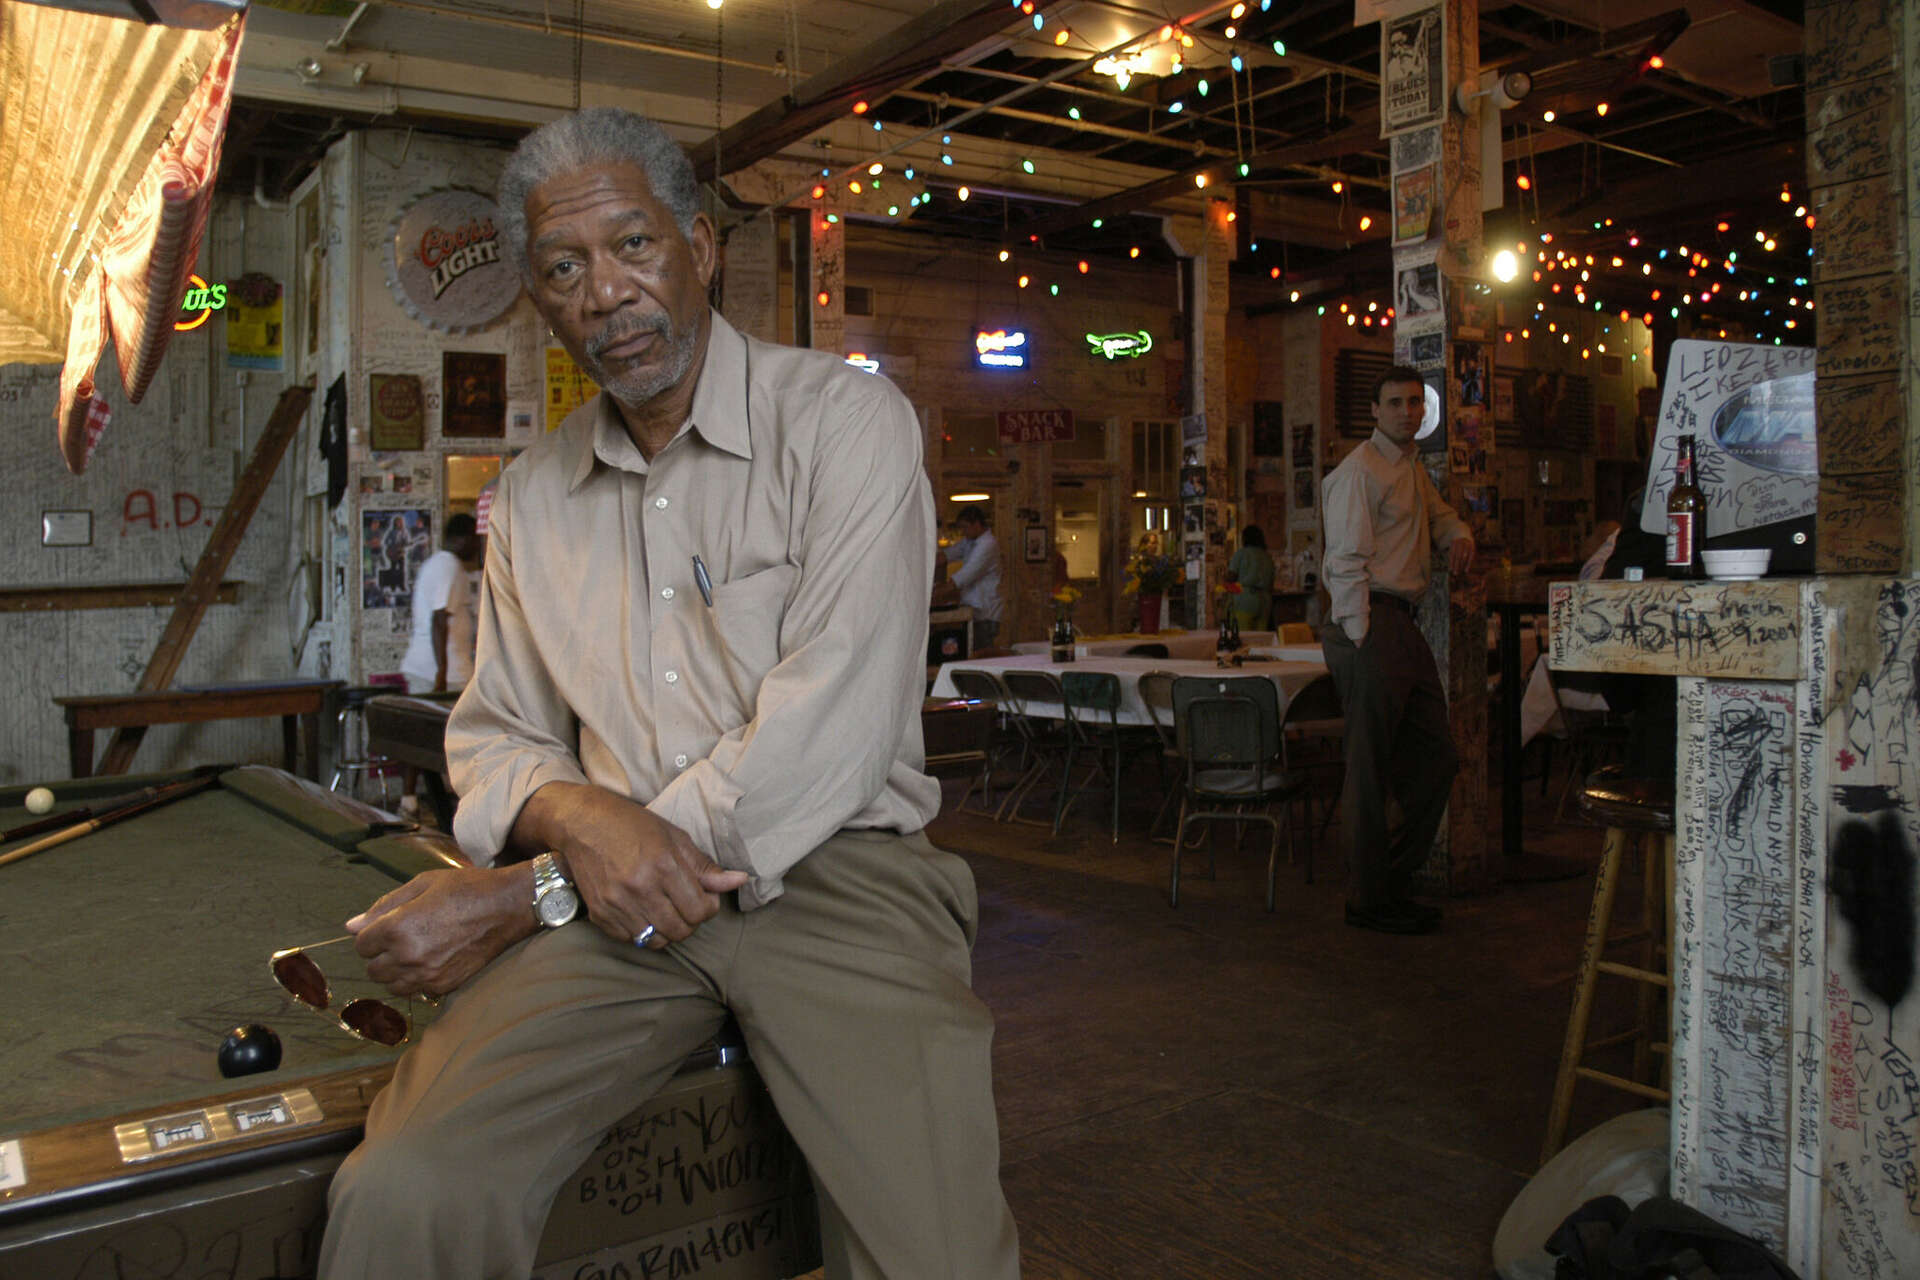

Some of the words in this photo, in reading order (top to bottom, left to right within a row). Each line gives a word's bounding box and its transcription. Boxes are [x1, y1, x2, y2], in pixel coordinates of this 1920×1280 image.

[1391, 90, 1428, 108] TODAY
[418, 217, 498, 268] Coors
[429, 240, 501, 301] LIGHT
[1006, 411, 1065, 429] SNACK
[1021, 426, 1056, 441] BAR
[118, 489, 214, 537] A.D.
[579, 1145, 682, 1204] BUSH
